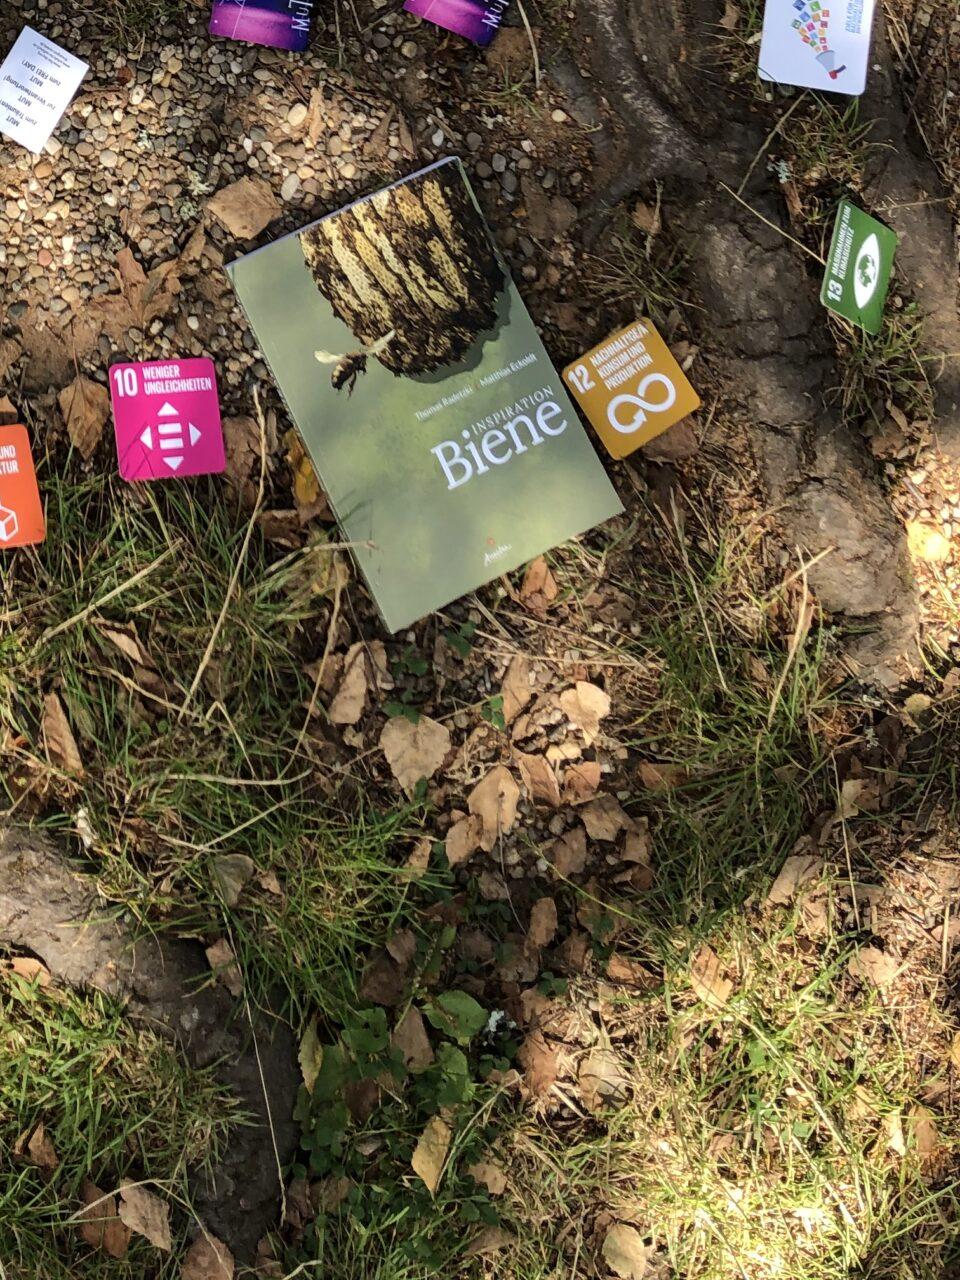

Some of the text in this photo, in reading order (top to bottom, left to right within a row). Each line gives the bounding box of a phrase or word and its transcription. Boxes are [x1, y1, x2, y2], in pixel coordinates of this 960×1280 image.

[29, 75, 44, 87] MUT
[18, 95, 32, 107] MUT
[6, 115, 20, 127] MUT
[842, 205, 851, 224] ZUM
[837, 227, 854, 280] KLIMASCHUTZ
[827, 279, 843, 302] 13
[142, 365, 180, 379] WENIGER
[598, 341, 645, 378] KONSUM UND
[604, 353, 653, 390] PRODUKTION
[114, 368, 138, 396] 10
[144, 378, 212, 395] UNGLEICHHEITEN
[568, 364, 596, 394] 12
[471, 385, 554, 436] INSPIRATION
[430, 385, 568, 490] Biene
